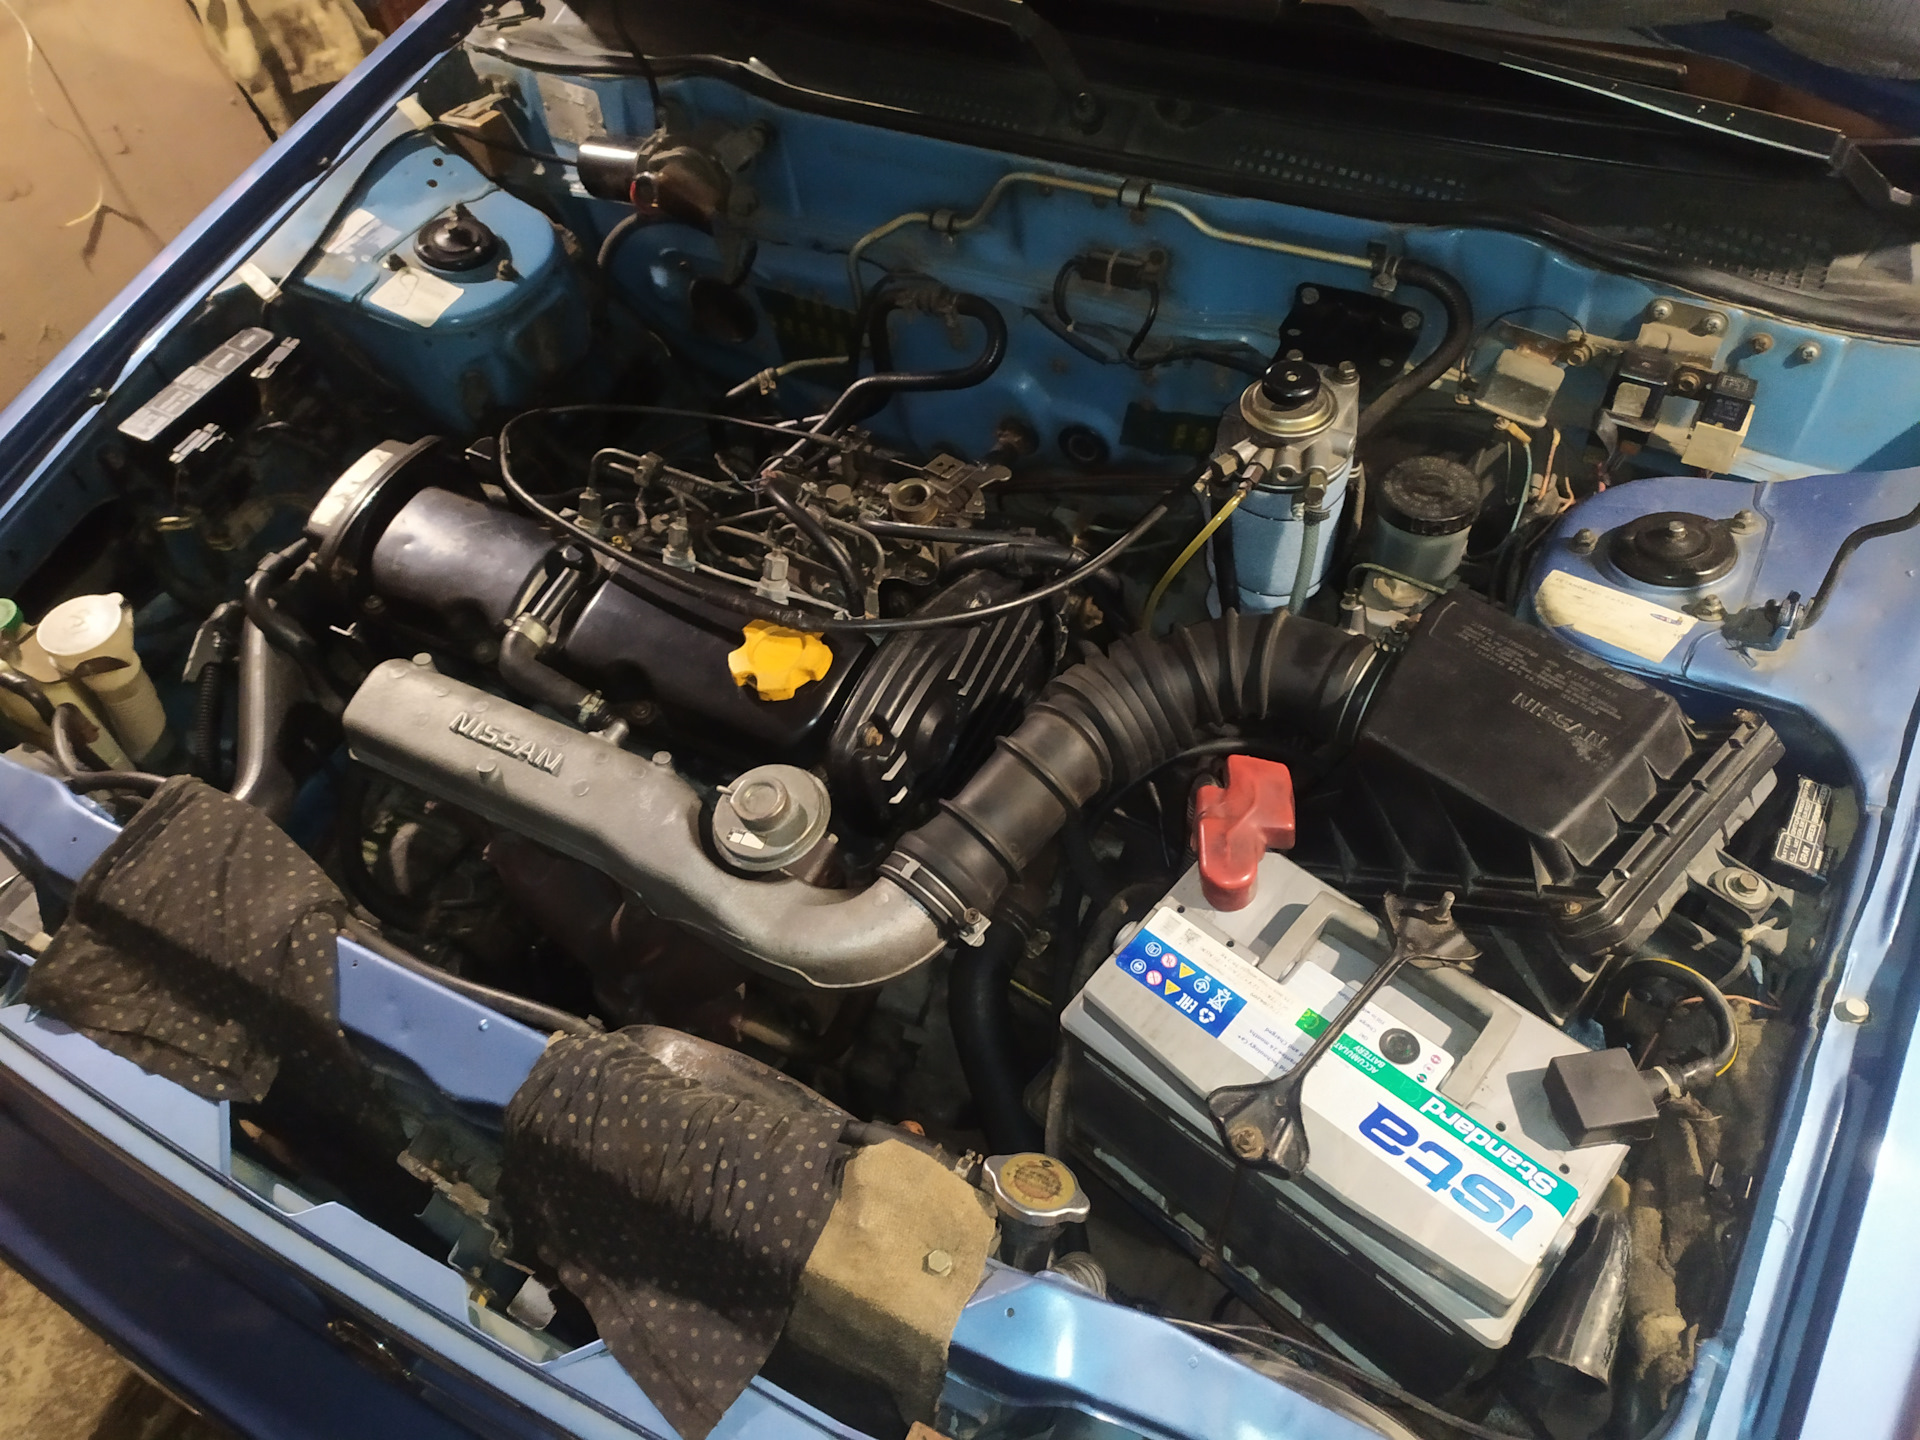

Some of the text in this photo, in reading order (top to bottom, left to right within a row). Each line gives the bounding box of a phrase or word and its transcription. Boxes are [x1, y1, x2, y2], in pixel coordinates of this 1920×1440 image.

[1510, 691, 1609, 749] NISSAN
[448, 710, 564, 777] NISSAN
[1799, 845, 1811, 863] GRAY
[1248, 1028, 1270, 1046] months
[1263, 1026, 1288, 1046] Charged
[1332, 1041, 1379, 1074] ACCUMULAT
[1352, 1044, 1386, 1068] BATTERY
[1419, 1095, 1558, 1196] Standard
